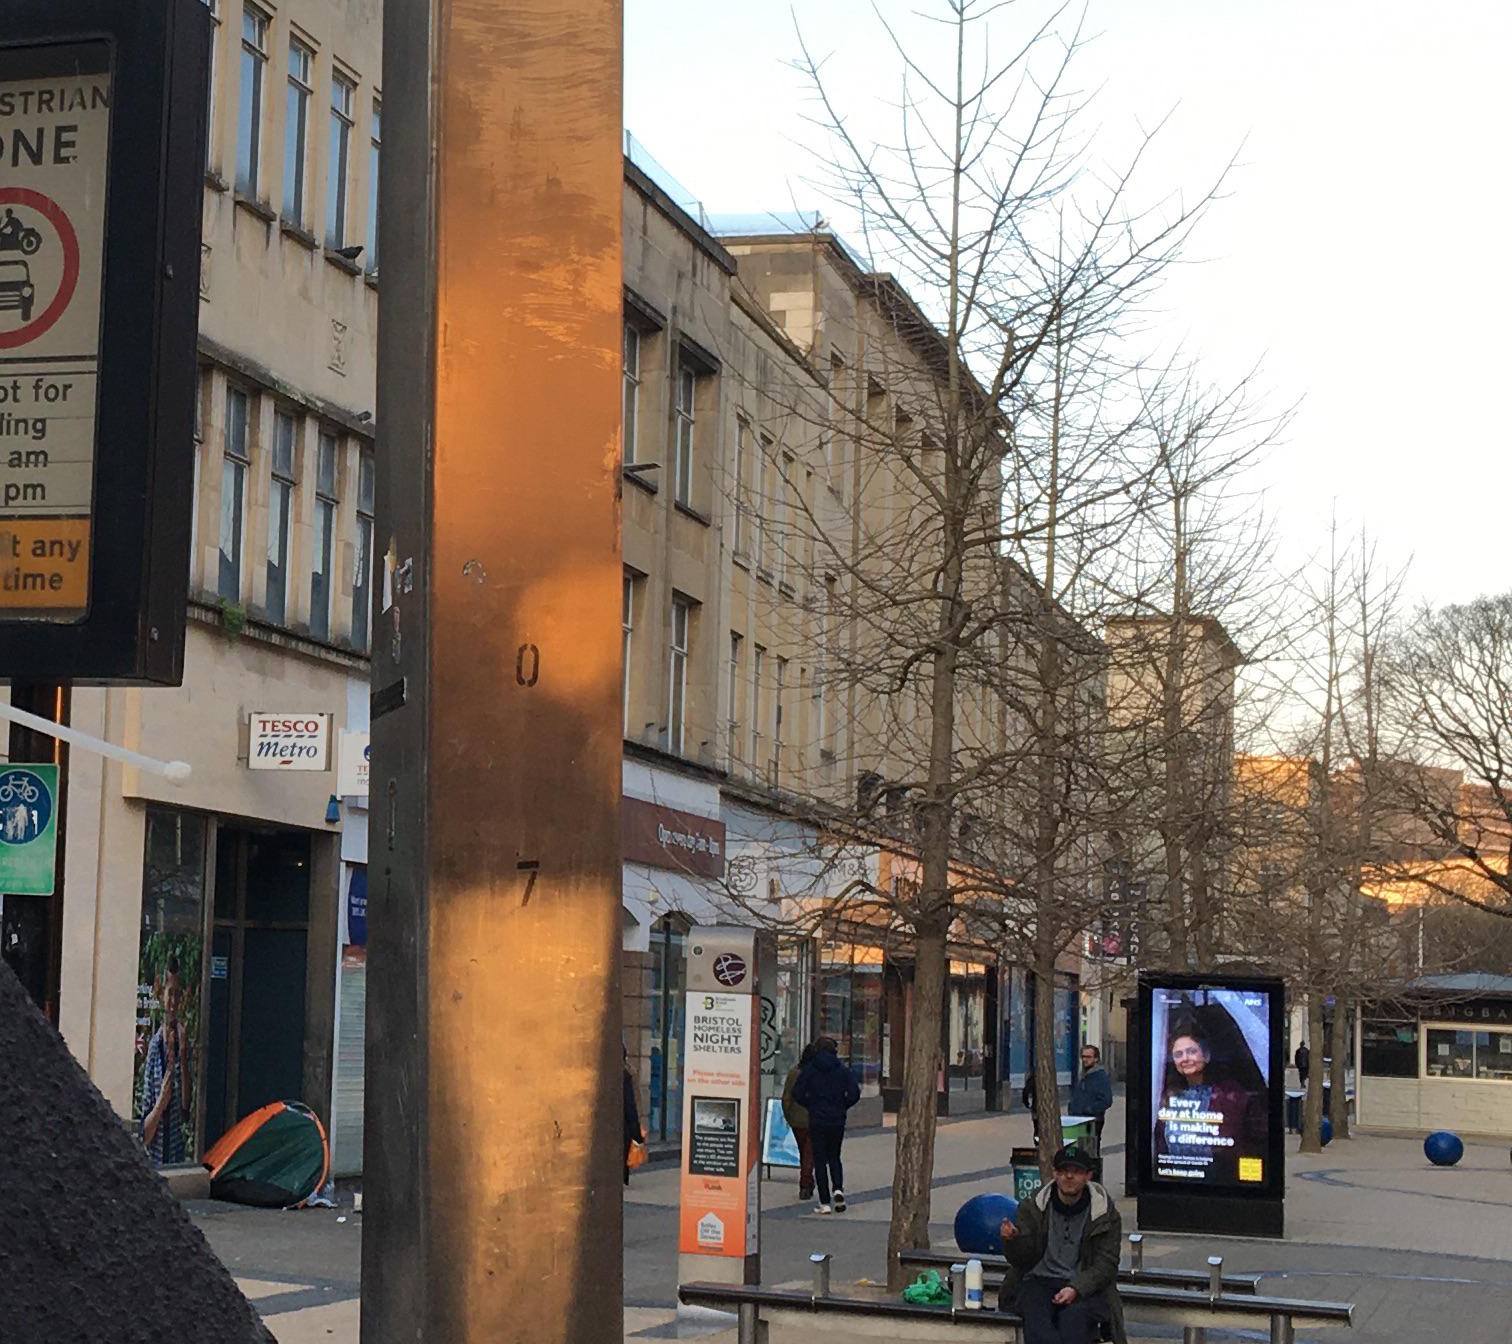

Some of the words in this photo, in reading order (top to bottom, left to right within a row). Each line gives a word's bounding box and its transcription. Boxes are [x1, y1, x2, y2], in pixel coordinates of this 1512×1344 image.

[33, 378, 73, 403] for
[31, 538, 82, 562] any
[258, 720, 319, 733] TESCO
[256, 740, 318, 758] Metro
[693, 1015, 742, 1027] BRISTOL
[693, 1025, 742, 1035] HOMELESS
[693, 1033, 743, 1045] NIGHT
[693, 1044, 742, 1054] SHELTERS
[1169, 1096, 1201, 1110] Every
[1158, 1107, 1177, 1120] day
[1178, 1110, 1190, 1119] at
[1192, 1109, 1223, 1120] home
[1169, 1121, 1178, 1131] is
[1180, 1122, 1220, 1135] making
[1169, 1135, 1176, 1143] a
[1178, 1134, 1235, 1146] difference
